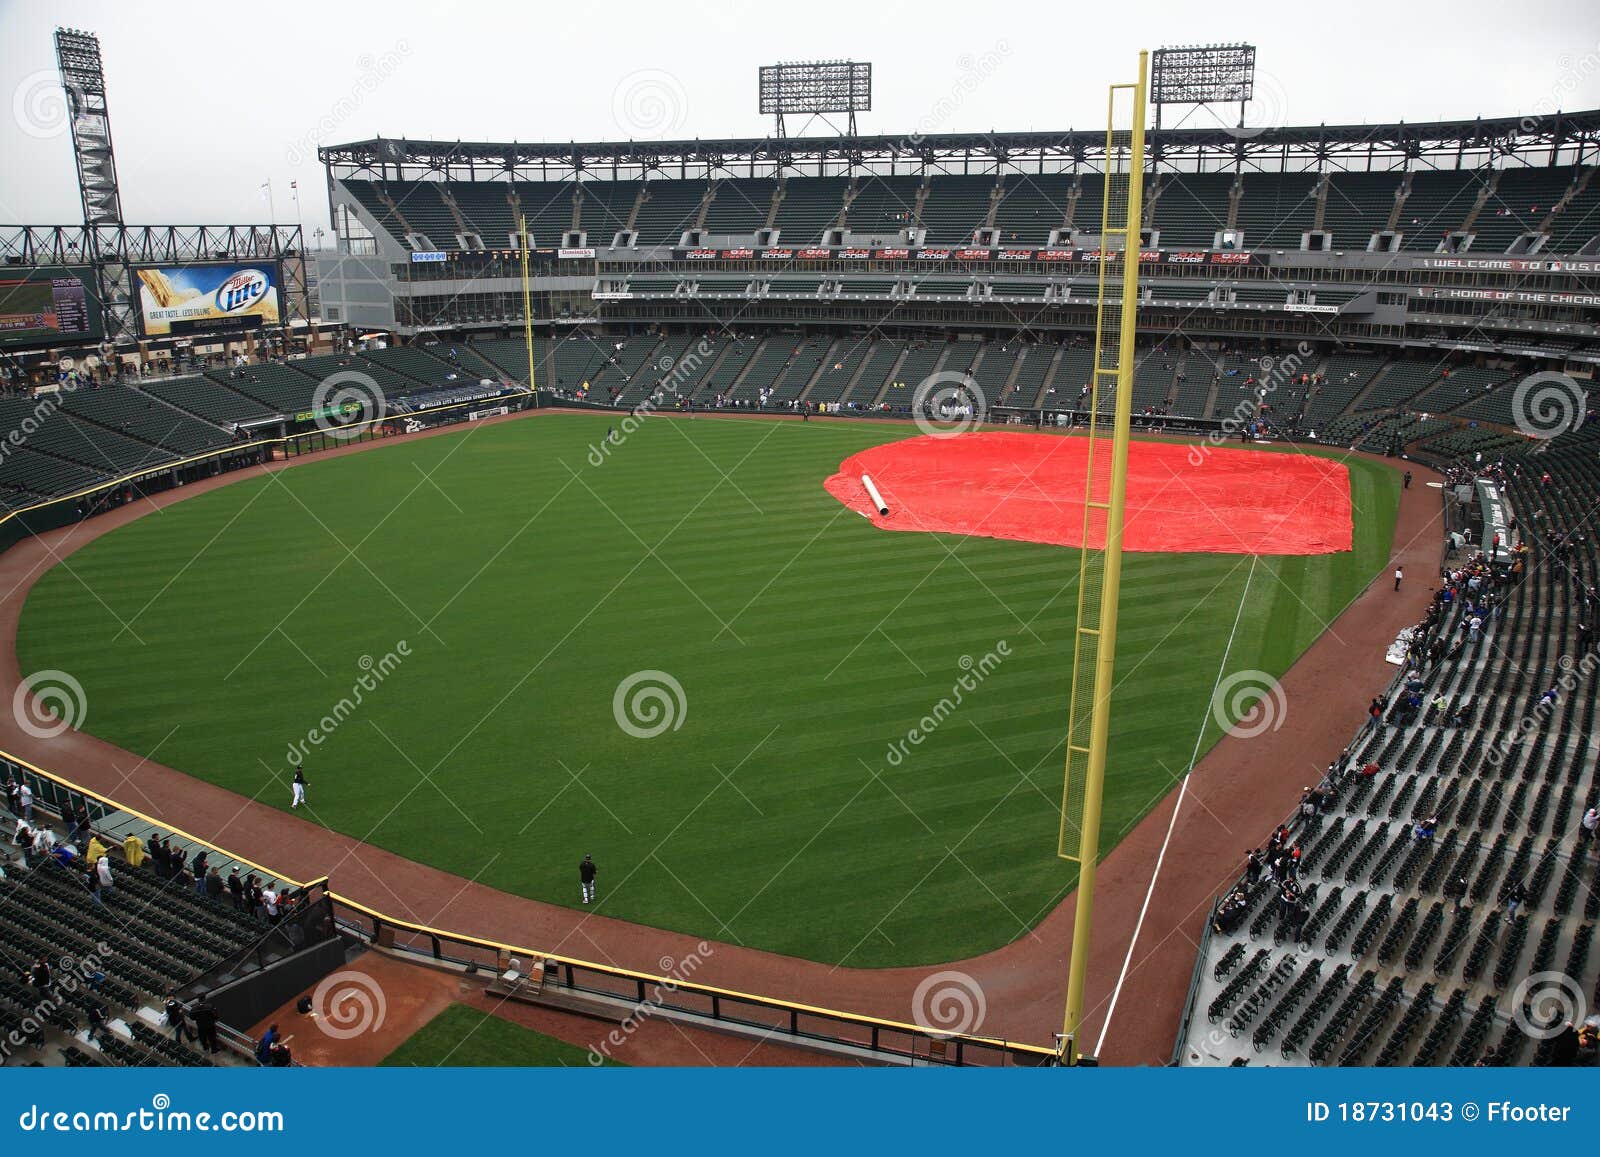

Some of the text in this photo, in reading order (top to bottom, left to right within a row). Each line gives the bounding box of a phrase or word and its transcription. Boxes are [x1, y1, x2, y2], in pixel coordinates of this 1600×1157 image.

[1434, 259, 1513, 269] WELCOME
[1519, 261, 1540, 270] TO
[231, 275, 255, 289] Miller
[226, 281, 263, 312] Lite
[1450, 290, 1492, 299] HOME
[1495, 292, 1514, 300] OF
[1517, 293, 1547, 302] THE
[150, 310, 164, 320] GREAT
[182, 308, 193, 317] LESS
